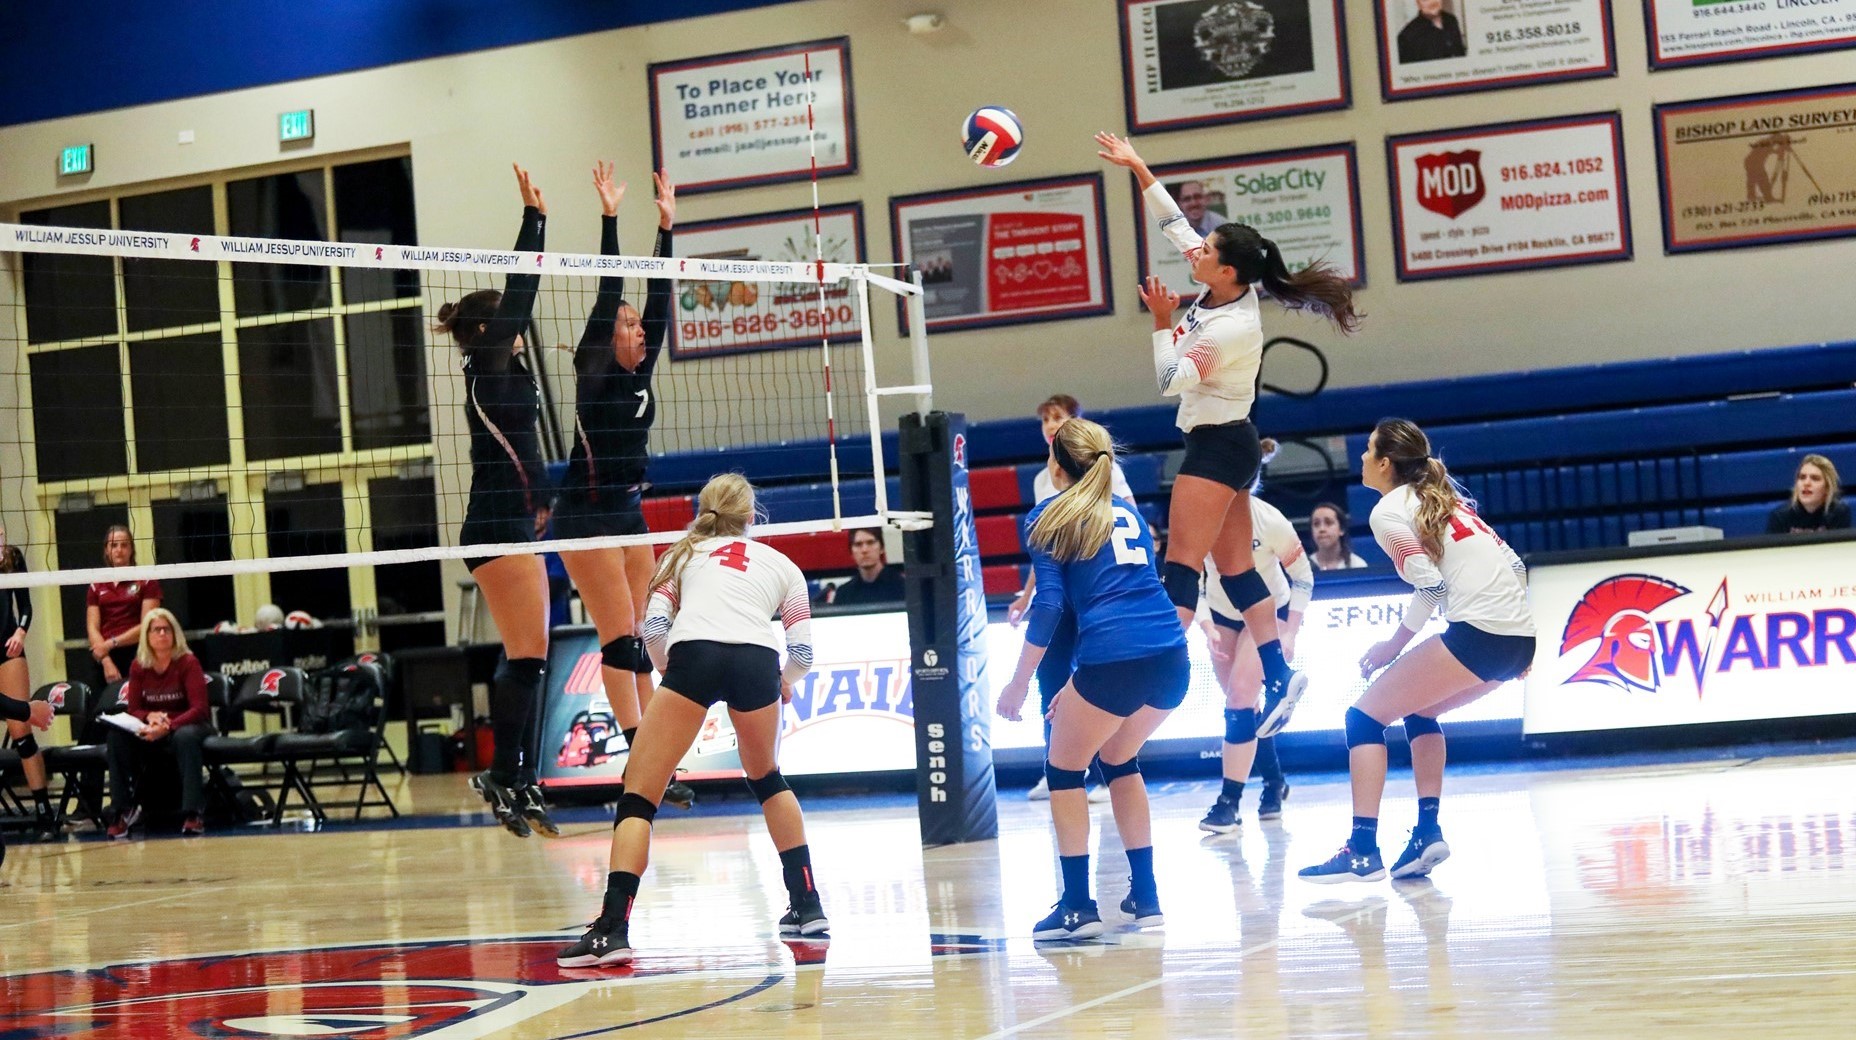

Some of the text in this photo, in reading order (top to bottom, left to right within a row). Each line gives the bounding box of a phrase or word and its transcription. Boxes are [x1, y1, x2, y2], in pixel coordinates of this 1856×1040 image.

[1777, 0, 1839, 9] LINC
[1485, 22, 1582, 44] 916.358.8018
[1746, 22, 1772, 33] Road
[1821, 15, 1837, 25] CA
[676, 67, 823, 101] To Place Your
[684, 90, 816, 119] Banner Here
[281, 111, 309, 141] EXIT
[689, 127, 714, 139] call
[1675, 121, 1737, 140] BISHOP
[1740, 115, 1784, 133] LAND
[62, 145, 88, 175] EXIT
[1501, 157, 1603, 182] 916.824.1052
[1234, 167, 1326, 196] SolarCity
[1422, 162, 1478, 199] MOD
[1501, 188, 1609, 211] MODpizza.com
[1237, 206, 1331, 224] 916.300.9640
[15, 229, 170, 250] WILLIAM JESSUP UNIVERSITY
[221, 241, 356, 260] WILLIAM JESSUP UNIVERSITY
[1571, 234, 1584, 245] CA
[401, 249, 520, 266] WILLIAM JESSUP UNIVERSITY
[559, 257, 592, 268] WILLIAM
[623, 259, 665, 271] UNIVERSITY
[699, 263, 730, 273] WILLAM
[731, 264, 755, 274] ESSUP
[682, 304, 853, 341] 916-626-3600
[634, 388, 649, 419] 7
[1110, 506, 1149, 566] 2
[709, 541, 750, 573] 4
[1744, 588, 1822, 604] WILLIAM
[954, 486, 983, 752] WARRIORS
[1656, 608, 1856, 701] WARR
[221, 659, 270, 677] molten
[927, 723, 947, 803] Senoh
